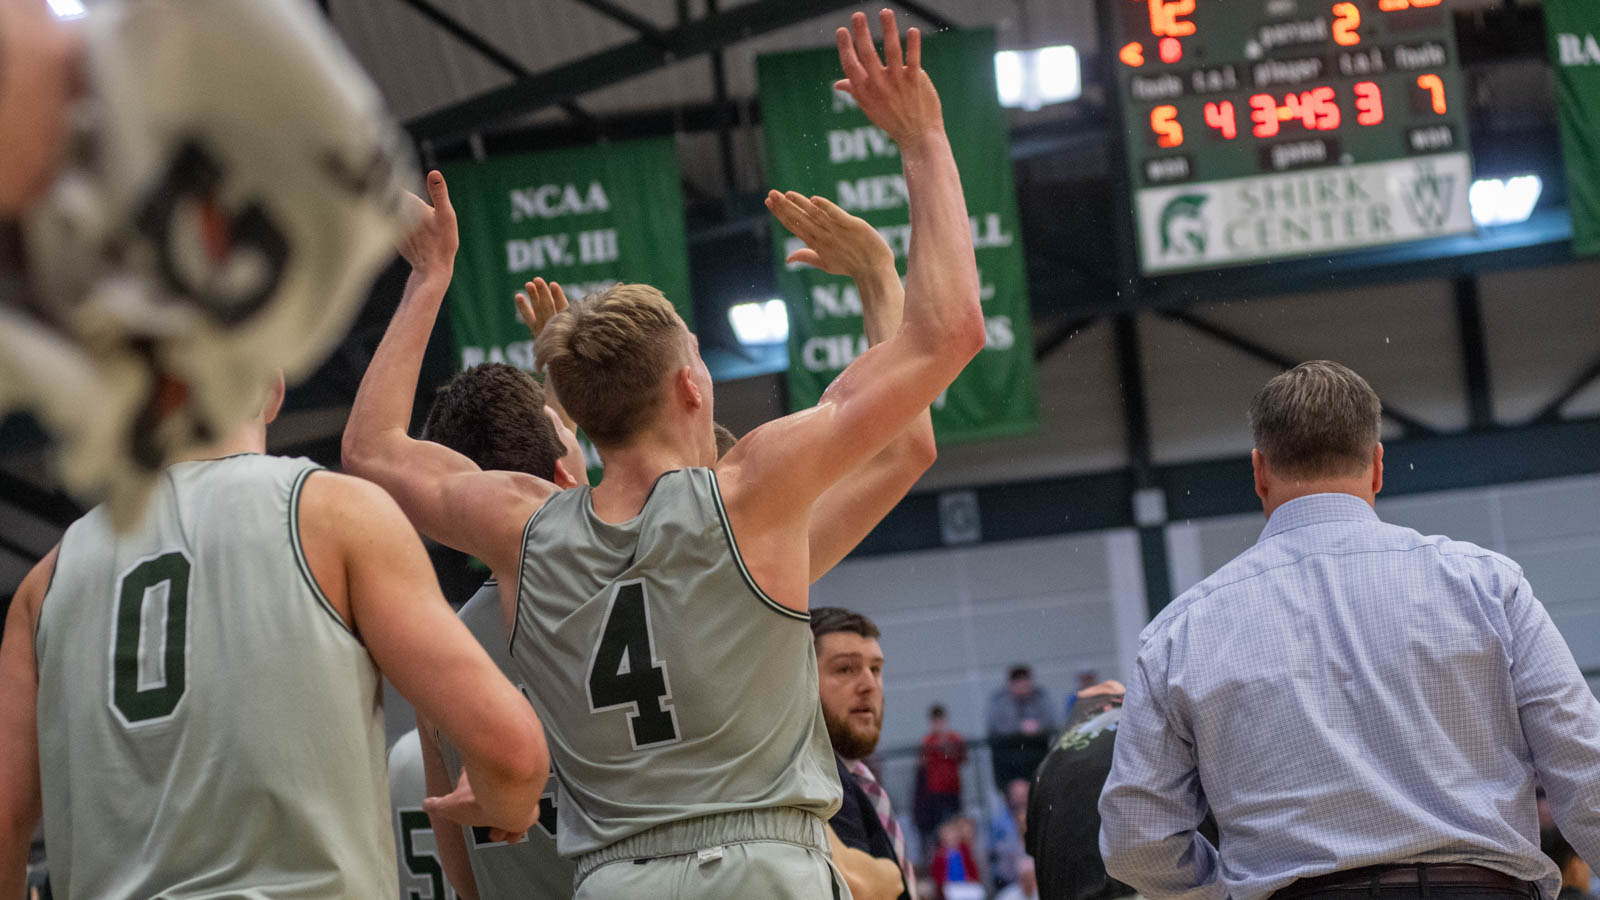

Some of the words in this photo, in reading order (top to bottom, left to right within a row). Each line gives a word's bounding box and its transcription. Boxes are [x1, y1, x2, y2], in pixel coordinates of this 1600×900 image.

[1332, 2, 1361, 46] 2
[1150, 104, 1184, 149] 5
[1203, 100, 1237, 140] 4
[1353, 81, 1384, 126] 3
[1417, 73, 1447, 115] 7
[509, 180, 610, 222] NCAA
[1238, 175, 1370, 214] SHIRK
[1225, 202, 1395, 249] CENTER
[506, 233, 574, 273] DIV.
[578, 228, 619, 265] III
[108, 549, 194, 729] 0
[587, 578, 682, 751] 4
